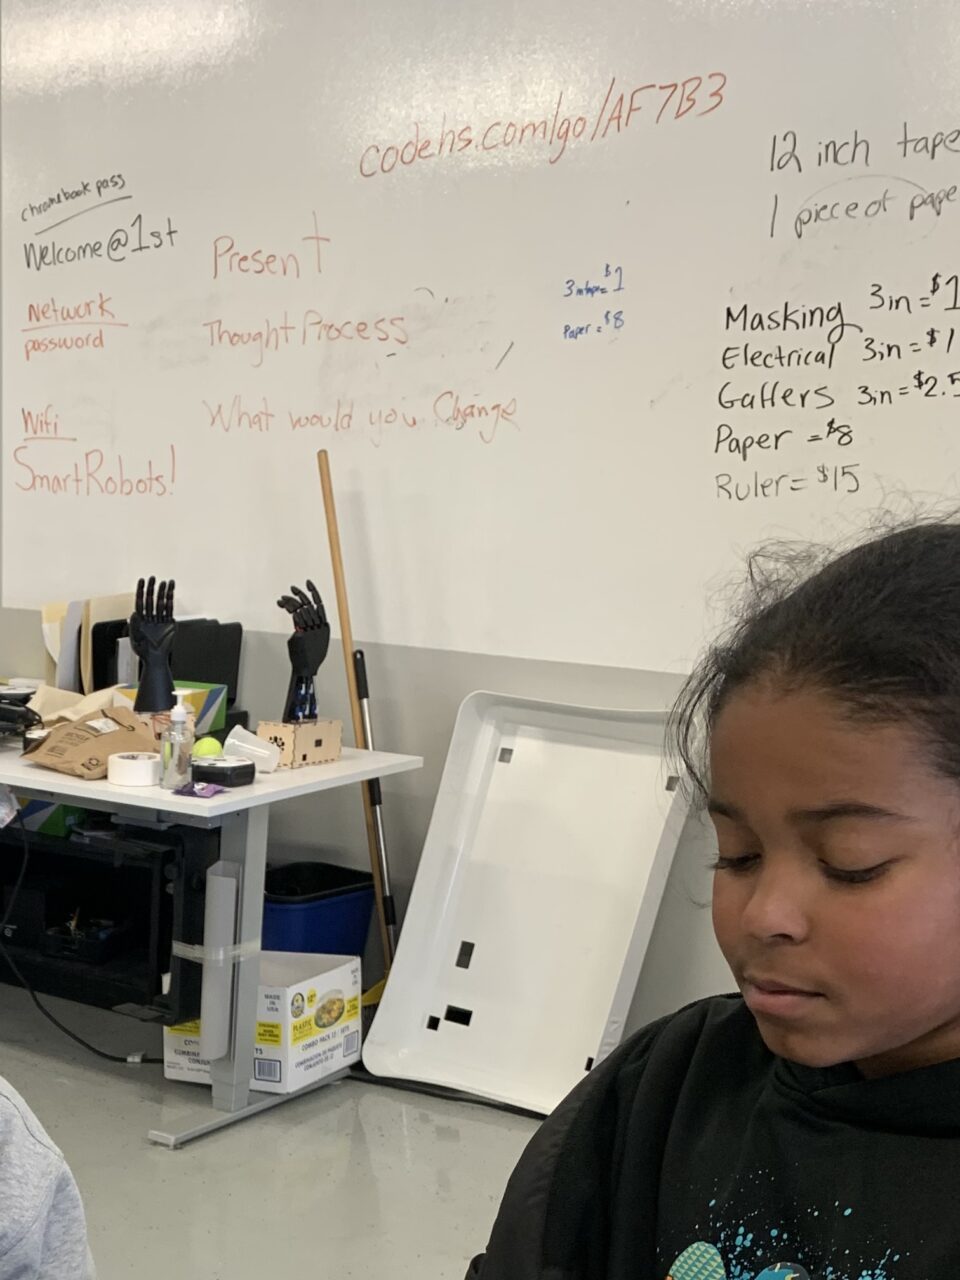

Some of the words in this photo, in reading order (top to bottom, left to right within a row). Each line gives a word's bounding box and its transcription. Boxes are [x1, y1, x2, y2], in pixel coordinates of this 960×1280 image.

[770, 130, 802, 173] 12
[817, 129, 870, 167] inch
[21, 181, 91, 222] chromebook
[96, 173, 126, 198] pass
[794, 201, 859, 239] piece
[212, 210, 331, 279] Present
[203, 310, 296, 367] Thought
[301, 309, 410, 345] Process
[724, 301, 863, 345] Masking
[24, 329, 105, 361] password
[721, 342, 836, 369] Electrical
[717, 380, 836, 410] Gaffers
[21, 404, 60, 437] Wifi
[203, 393, 276, 433] What
[289, 398, 354, 433] would
[368, 405, 417, 447] you
[432, 390, 520, 444] Change
[714, 423, 794, 461] Paper
